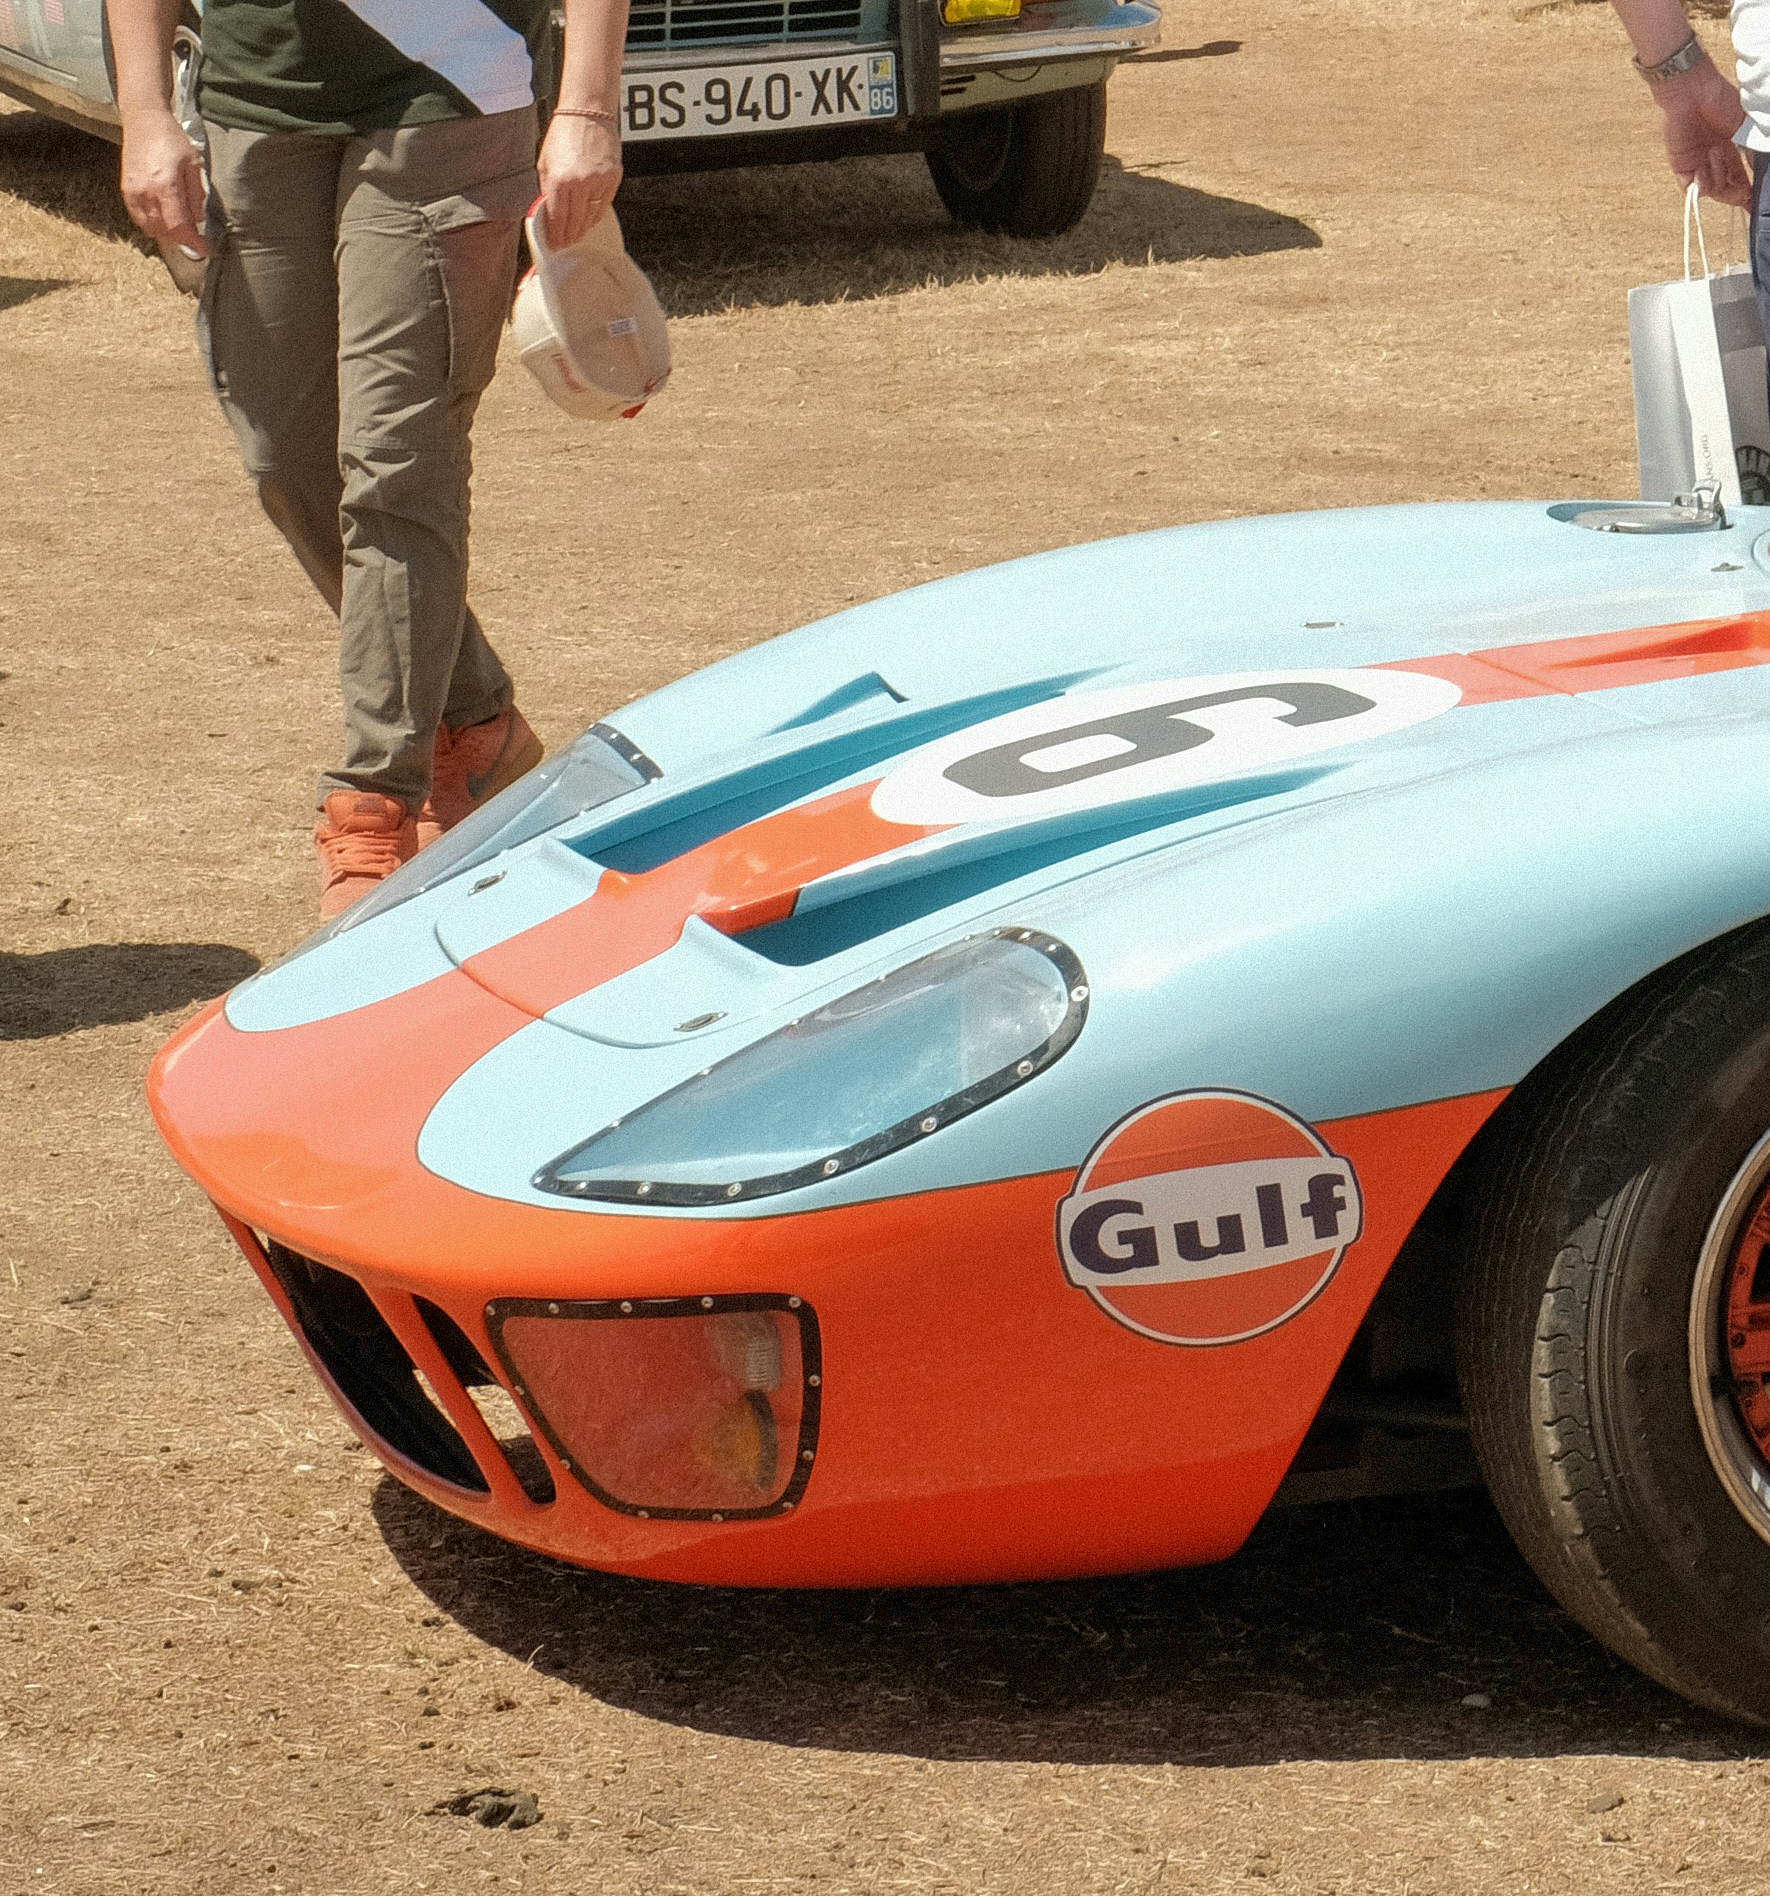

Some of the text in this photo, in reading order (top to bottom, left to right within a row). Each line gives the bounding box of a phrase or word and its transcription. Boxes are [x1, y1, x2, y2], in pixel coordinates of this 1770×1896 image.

[870, 88, 894, 111] 86
[943, 682, 1377, 798] 6
[1069, 1172, 1347, 1275] Gulf
